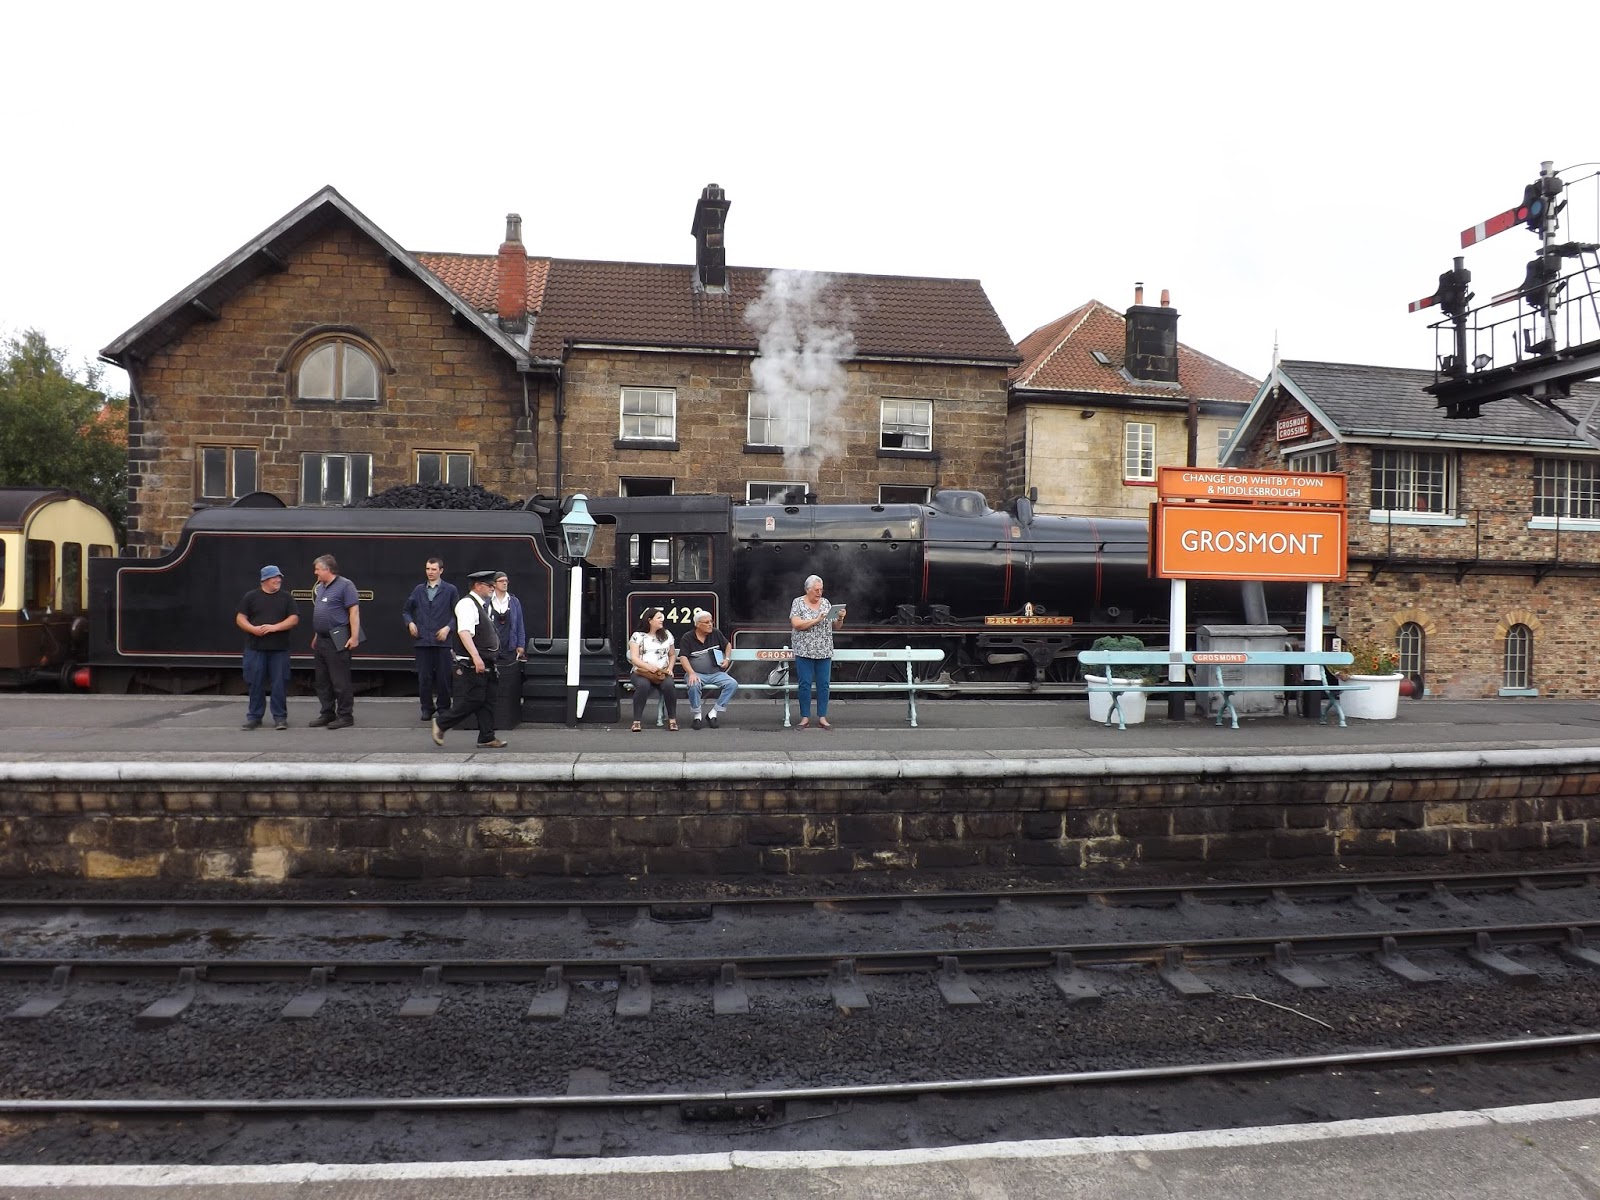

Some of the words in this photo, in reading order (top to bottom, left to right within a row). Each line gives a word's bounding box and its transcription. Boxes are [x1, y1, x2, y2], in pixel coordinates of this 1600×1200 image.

[1279, 416, 1308, 430] GROSMONT
[1279, 425, 1308, 438] CROSSING
[1182, 473, 1226, 484] CHANGE
[1228, 475, 1248, 485] FOR
[1250, 476, 1289, 487] WHITBY
[1291, 477, 1323, 487] TOWN
[1207, 485, 1215, 494] &
[1217, 486, 1301, 497] MIDDLESBROUGH
[1181, 530, 1323, 555] GROSMONT
[1020, 617, 1070, 625] TREACY
[761, 651, 795, 659] GROSM
